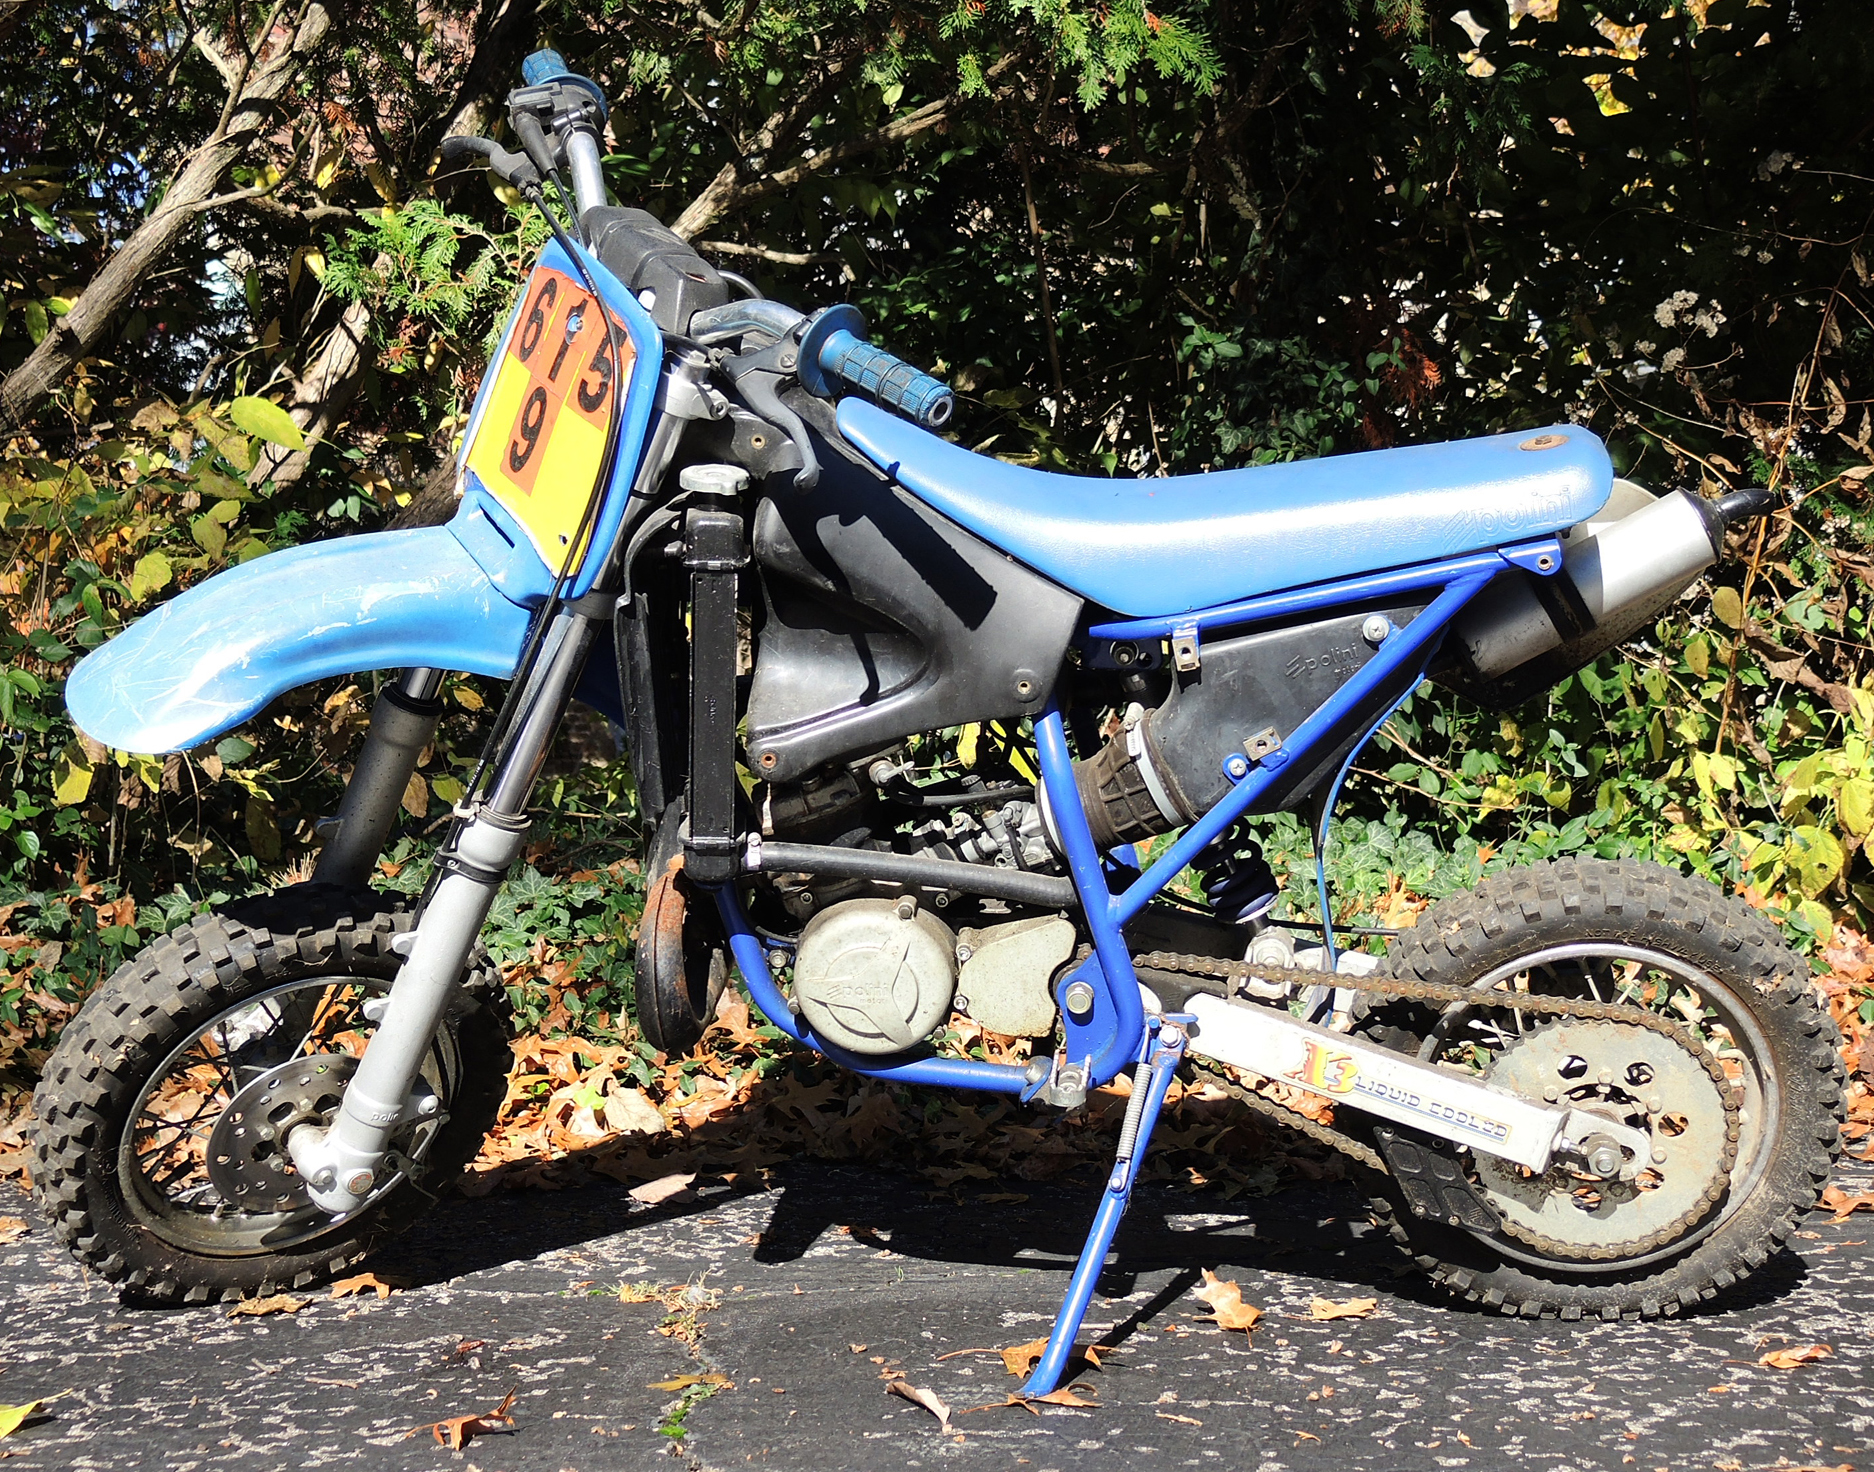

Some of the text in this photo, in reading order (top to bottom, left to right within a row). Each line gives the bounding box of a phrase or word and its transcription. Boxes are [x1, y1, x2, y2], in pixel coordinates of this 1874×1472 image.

[509, 386, 548, 474] 9
[1305, 643, 1359, 676] polini
[1355, 1076, 1421, 1107] LIQUID
[1429, 1102, 1508, 1137] COOLED
